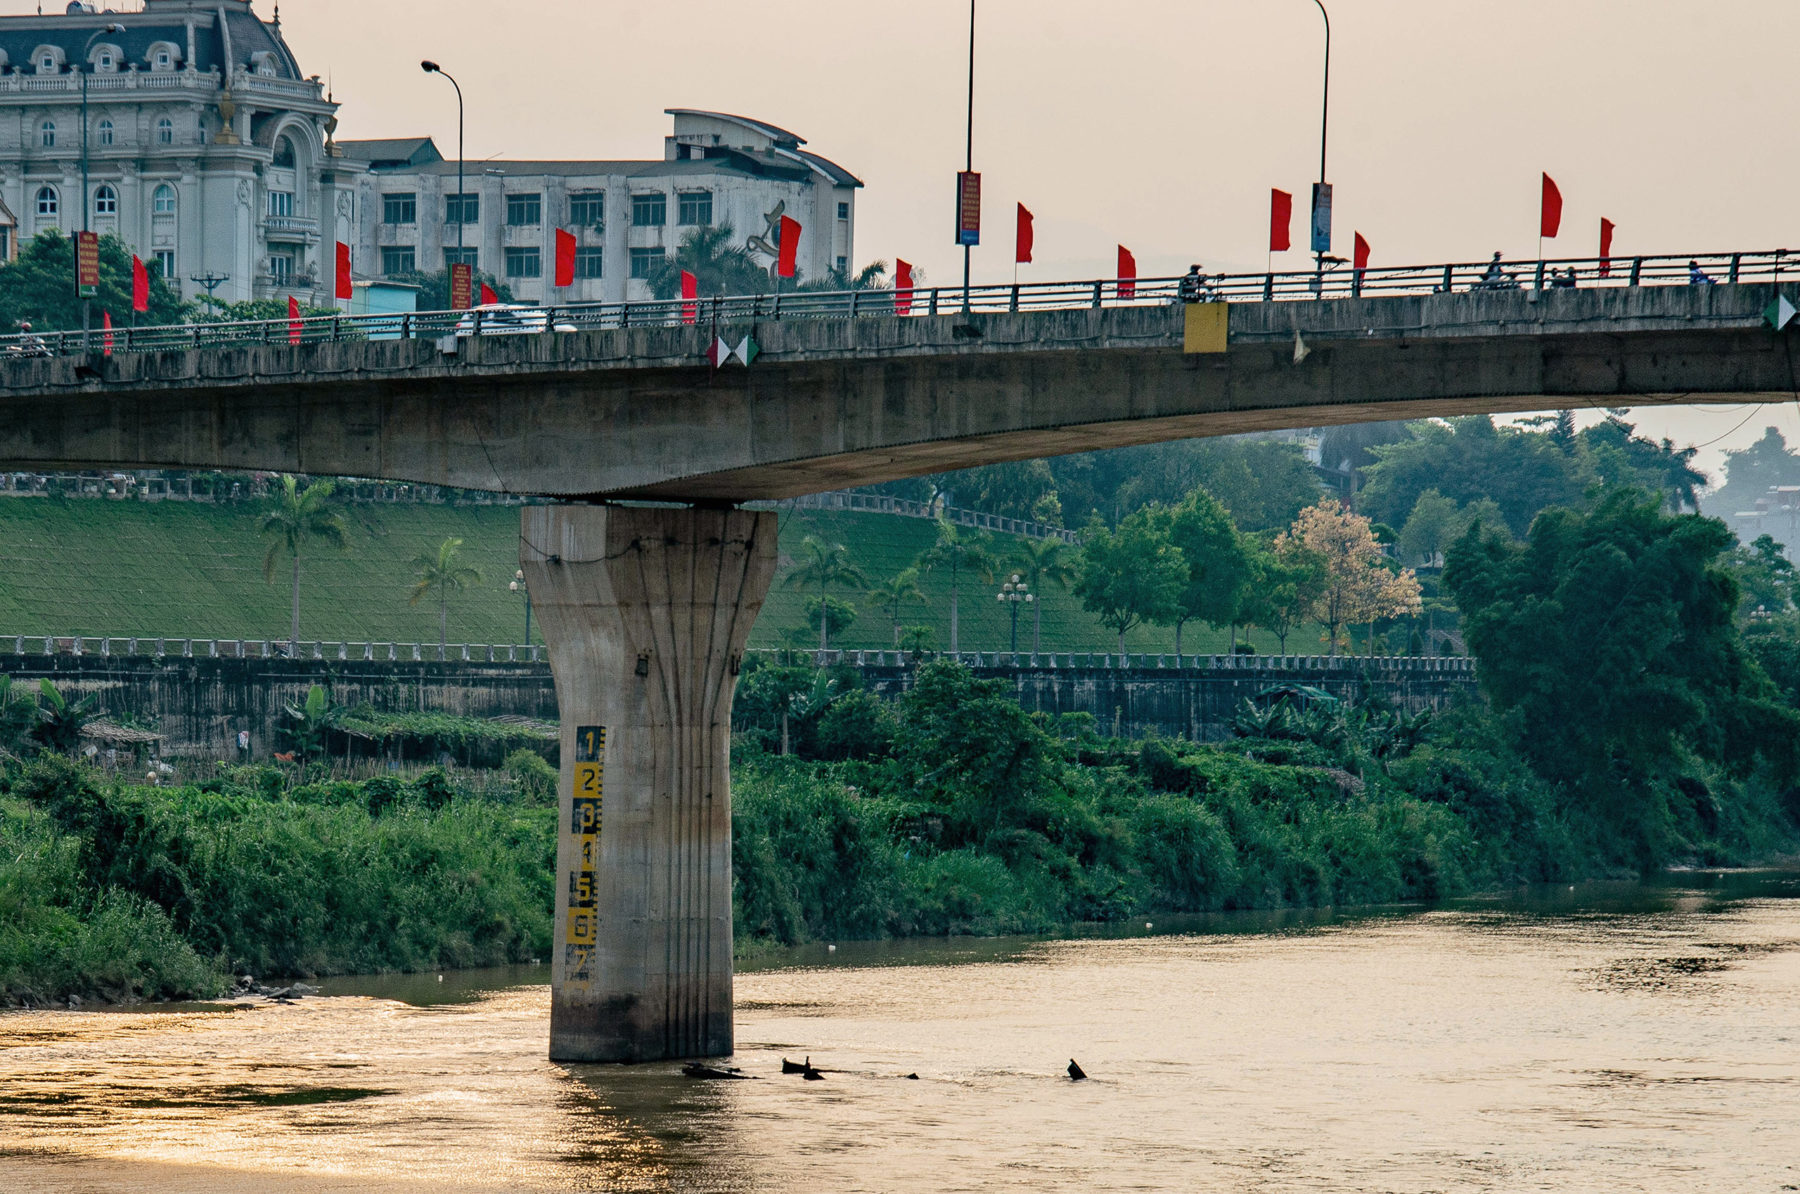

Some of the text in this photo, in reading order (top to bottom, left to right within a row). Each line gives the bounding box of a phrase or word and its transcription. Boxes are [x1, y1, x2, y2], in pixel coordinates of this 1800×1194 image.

[585, 731, 594, 755] 1
[582, 769, 595, 791] 2
[580, 803, 595, 827] 3
[583, 841, 591, 864] 4
[575, 877, 591, 901] 5
[574, 914, 588, 937] 6
[574, 950, 588, 973] 7
